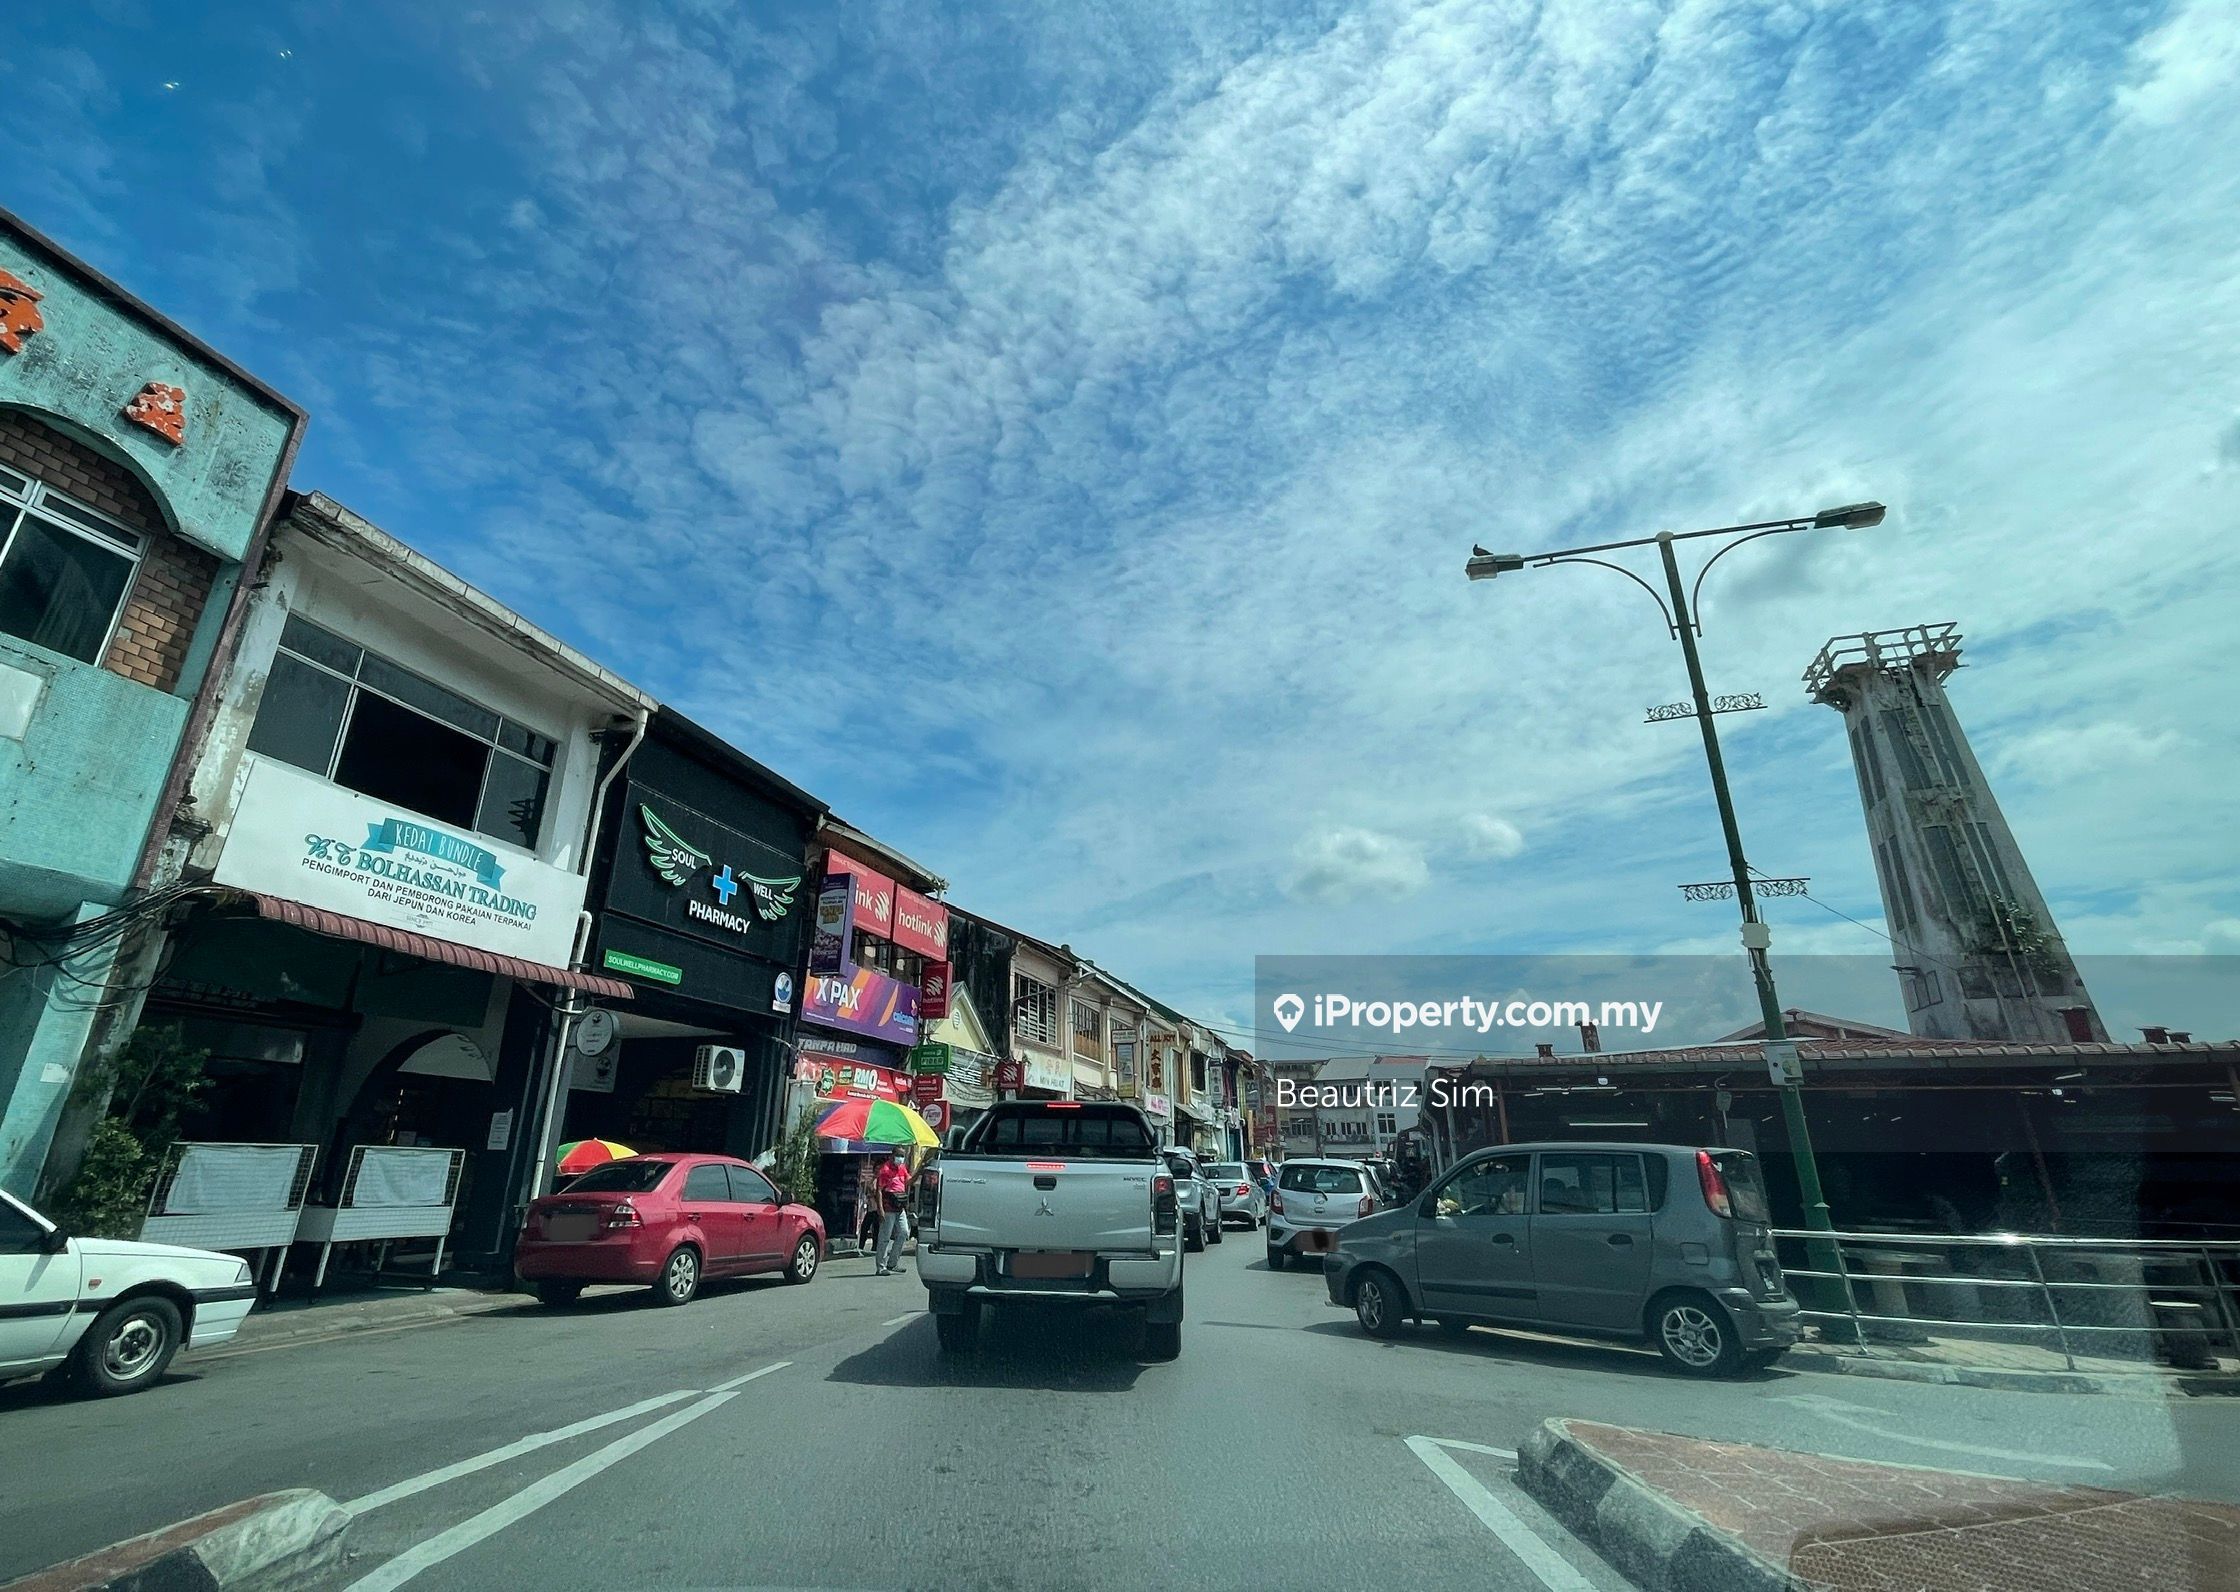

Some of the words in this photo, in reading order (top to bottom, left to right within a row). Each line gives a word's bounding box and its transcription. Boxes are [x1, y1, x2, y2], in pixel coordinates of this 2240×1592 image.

[395, 823, 433, 852] KEDAI
[438, 836, 484, 872] BUNDLE
[301, 858, 371, 885] PENGIMPORT
[372, 879, 394, 892] DAN
[395, 885, 454, 910] PEMBORONG
[455, 903, 492, 920] PAKAIAN
[494, 914, 532, 931] TERPAKAI
[355, 851, 467, 900] BOLHASSAN
[468, 885, 537, 921] TRADING
[671, 848, 696, 870] SOUL
[753, 882, 773, 901] WELL
[367, 888, 392, 902] DARI
[393, 896, 424, 911] JEPUN
[425, 905, 444, 918] DAN
[446, 911, 476, 926] KOREA
[689, 900, 750, 934] PHARMACY
[898, 907, 933, 938] hotlink
